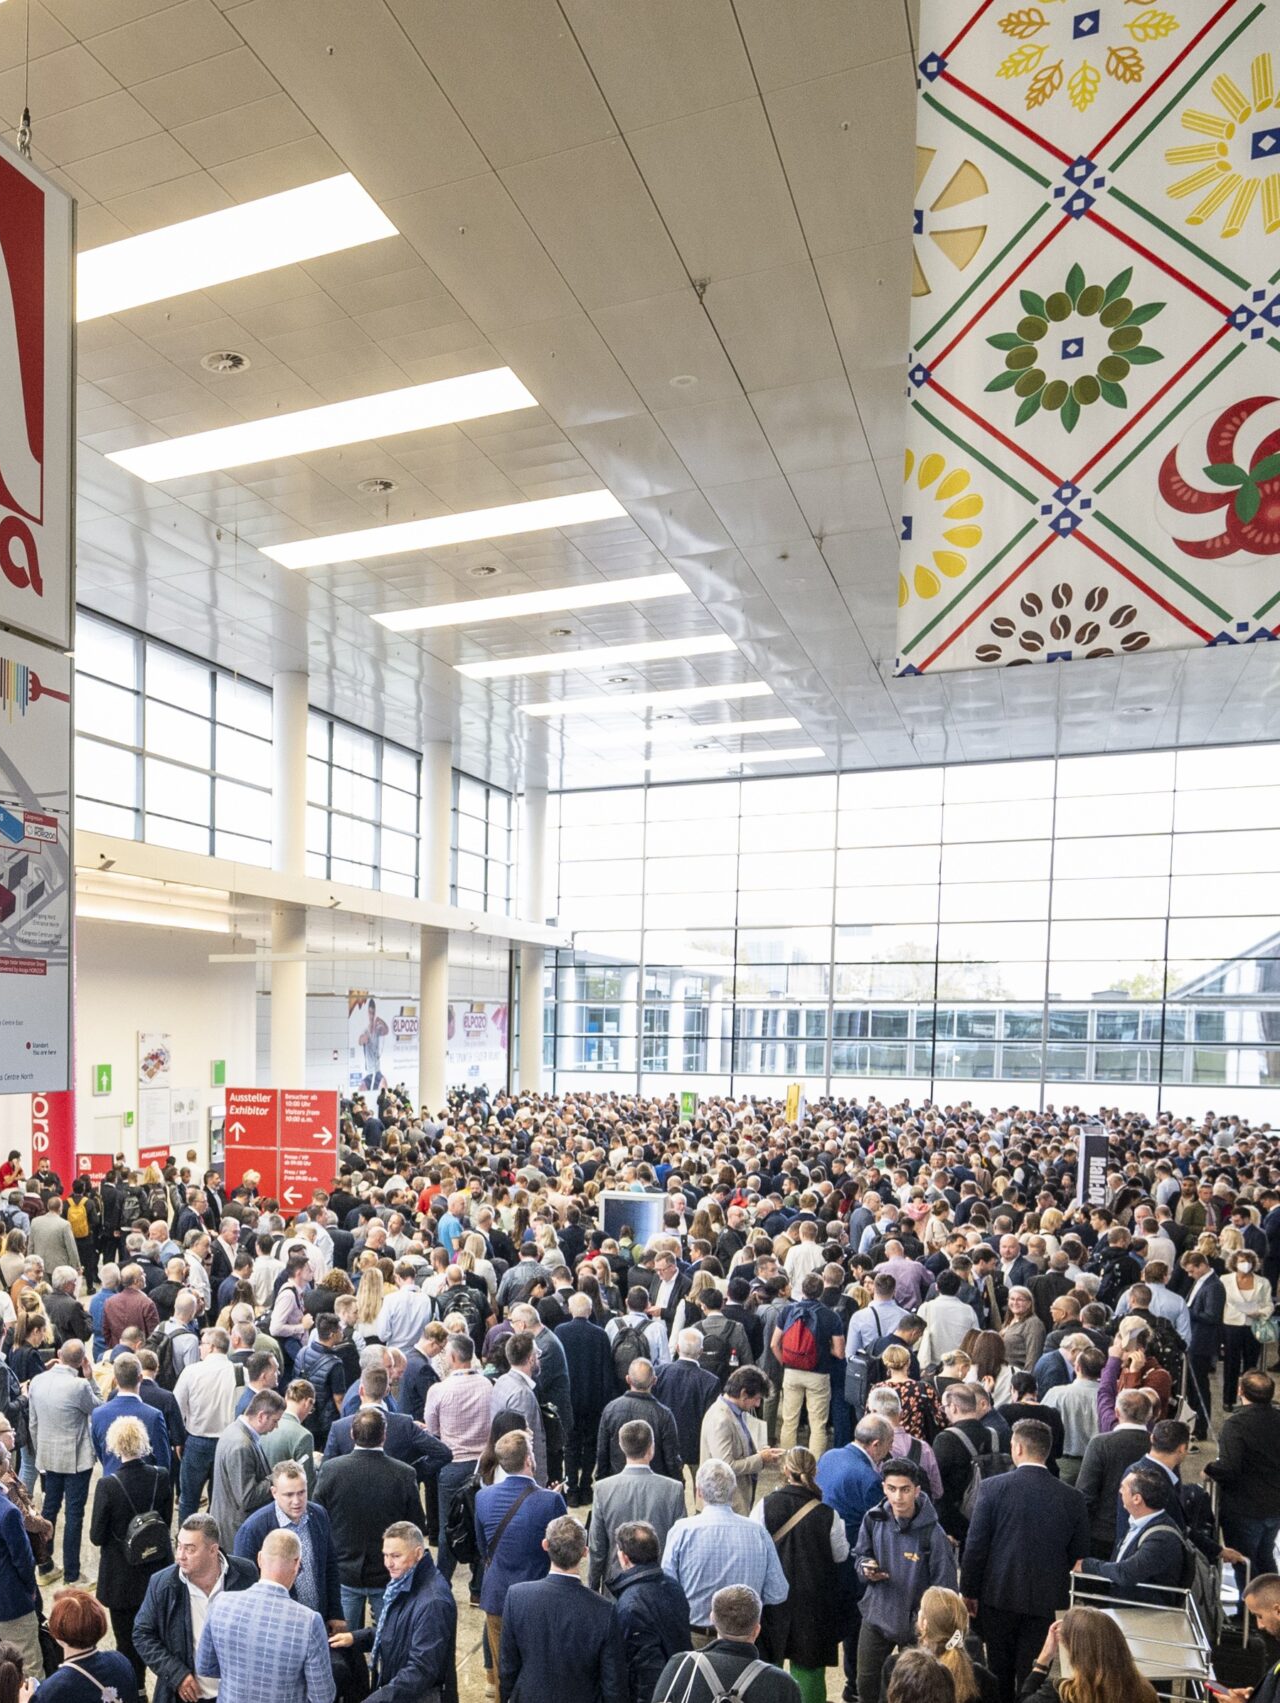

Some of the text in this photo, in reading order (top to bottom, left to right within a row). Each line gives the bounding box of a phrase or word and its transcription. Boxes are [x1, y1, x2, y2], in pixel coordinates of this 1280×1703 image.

[229, 1093, 272, 1103] Aussteller
[229, 1106, 269, 1115] Exhibitor
[33, 1092, 49, 1152] ore
